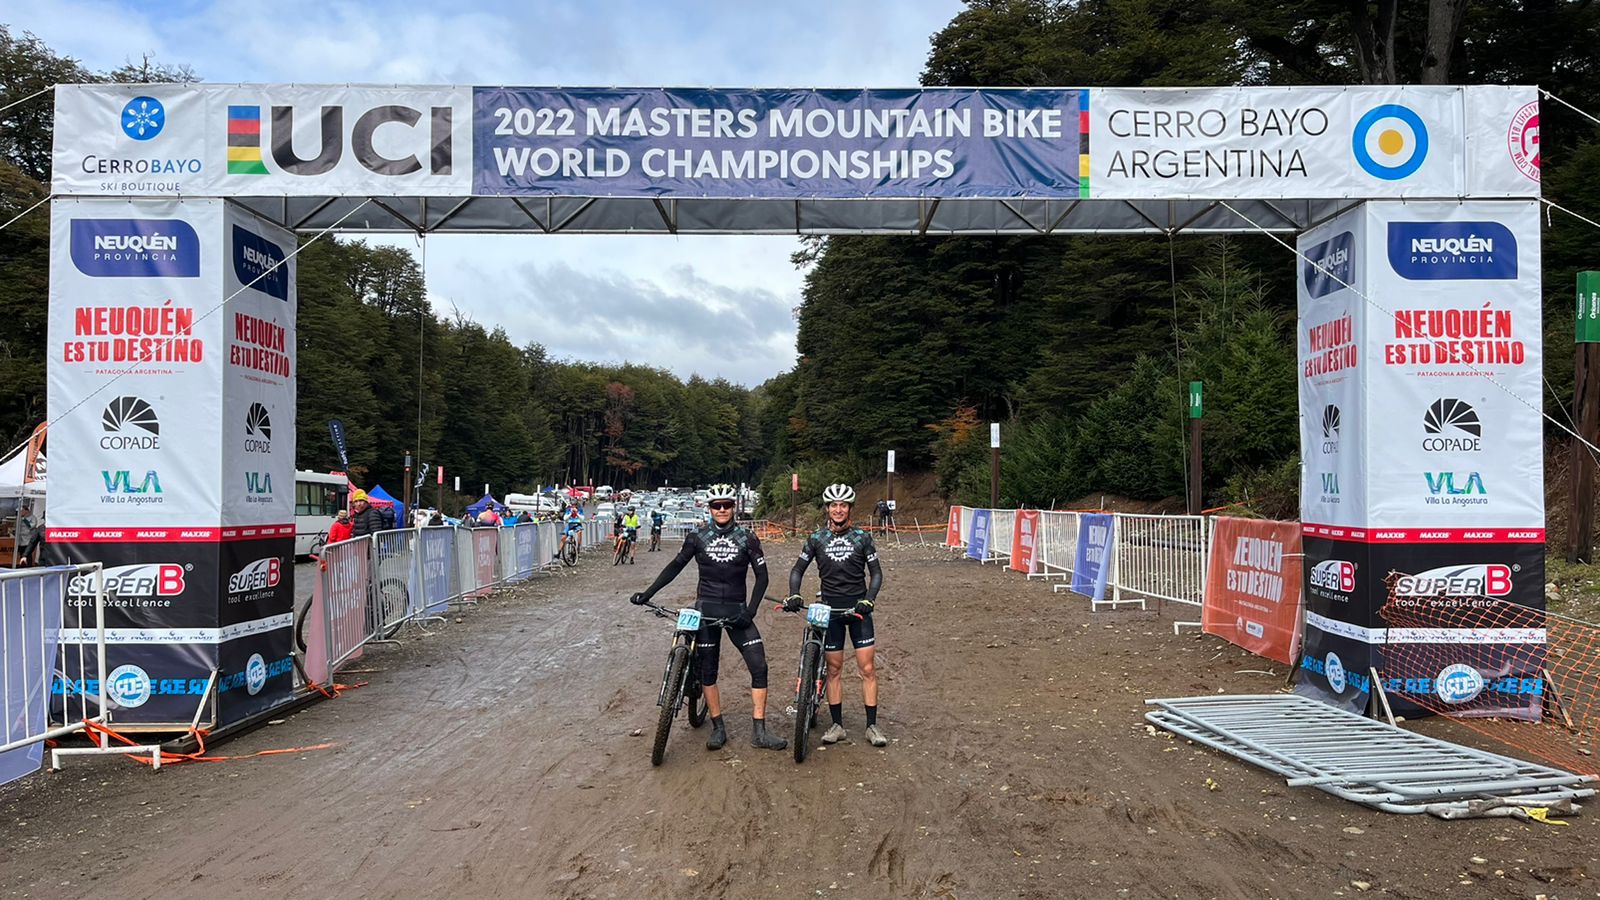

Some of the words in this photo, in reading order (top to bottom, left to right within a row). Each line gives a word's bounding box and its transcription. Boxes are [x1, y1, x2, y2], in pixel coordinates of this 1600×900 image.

[494, 107, 576, 136] 2022
[586, 107, 758, 138] MASTERS
[769, 107, 971, 138] MOUNTAIN
[983, 108, 1062, 138] BIKE
[1108, 109, 1226, 138] CERRO
[1241, 108, 1328, 136] BAYO
[271, 105, 453, 176] UCI
[1511, 126, 1521, 142] MTB
[493, 147, 631, 177] WORLD
[641, 148, 954, 179] CHAMPIONSHIPS
[1107, 149, 1308, 178] ARGENTINA
[100, 182, 117, 191] SKI
[121, 182, 180, 192] BOUTIQUE
[94, 232, 177, 253] NEUQUÉN
[1412, 234, 1493, 256] NEUQUÉN
[94, 253, 177, 261] PROVINCIA
[243, 245, 278, 272] NEUQUÉN
[1411, 256, 1493, 264] PROVINCIA
[75, 299, 193, 337] NEUQUÉN
[1395, 301, 1511, 339] NEUQUÉN
[235, 312, 285, 353] NEUQUÉN
[64, 341, 85, 362] ES
[87, 341, 109, 362] TU
[113, 338, 203, 363] DESTINO
[230, 344, 240, 366] ES
[241, 347, 251, 368] TU
[1322, 344, 1357, 374] DESTNO
[1385, 344, 1406, 364] ES
[1408, 344, 1430, 364] TU
[1435, 341, 1524, 364] DESTINO
[100, 436, 160, 450] COPADE
[244, 439, 271, 453] COPADE
[1422, 438, 1482, 451] COPADE
[102, 470, 163, 493] VLA
[245, 472, 272, 494] VLA
[1424, 472, 1487, 494] VLA
[128, 496, 163, 506] Angostura
[1425, 496, 1440, 504] Villa
[1441, 496, 1450, 504] La
[1452, 496, 1488, 507] Angostura
[1227, 569, 1237, 591] ES
[1237, 570, 1248, 593] TU
[1248, 570, 1283, 603] DESTINO
[680, 613, 699, 627] 272
[811, 608, 829, 622] 102
